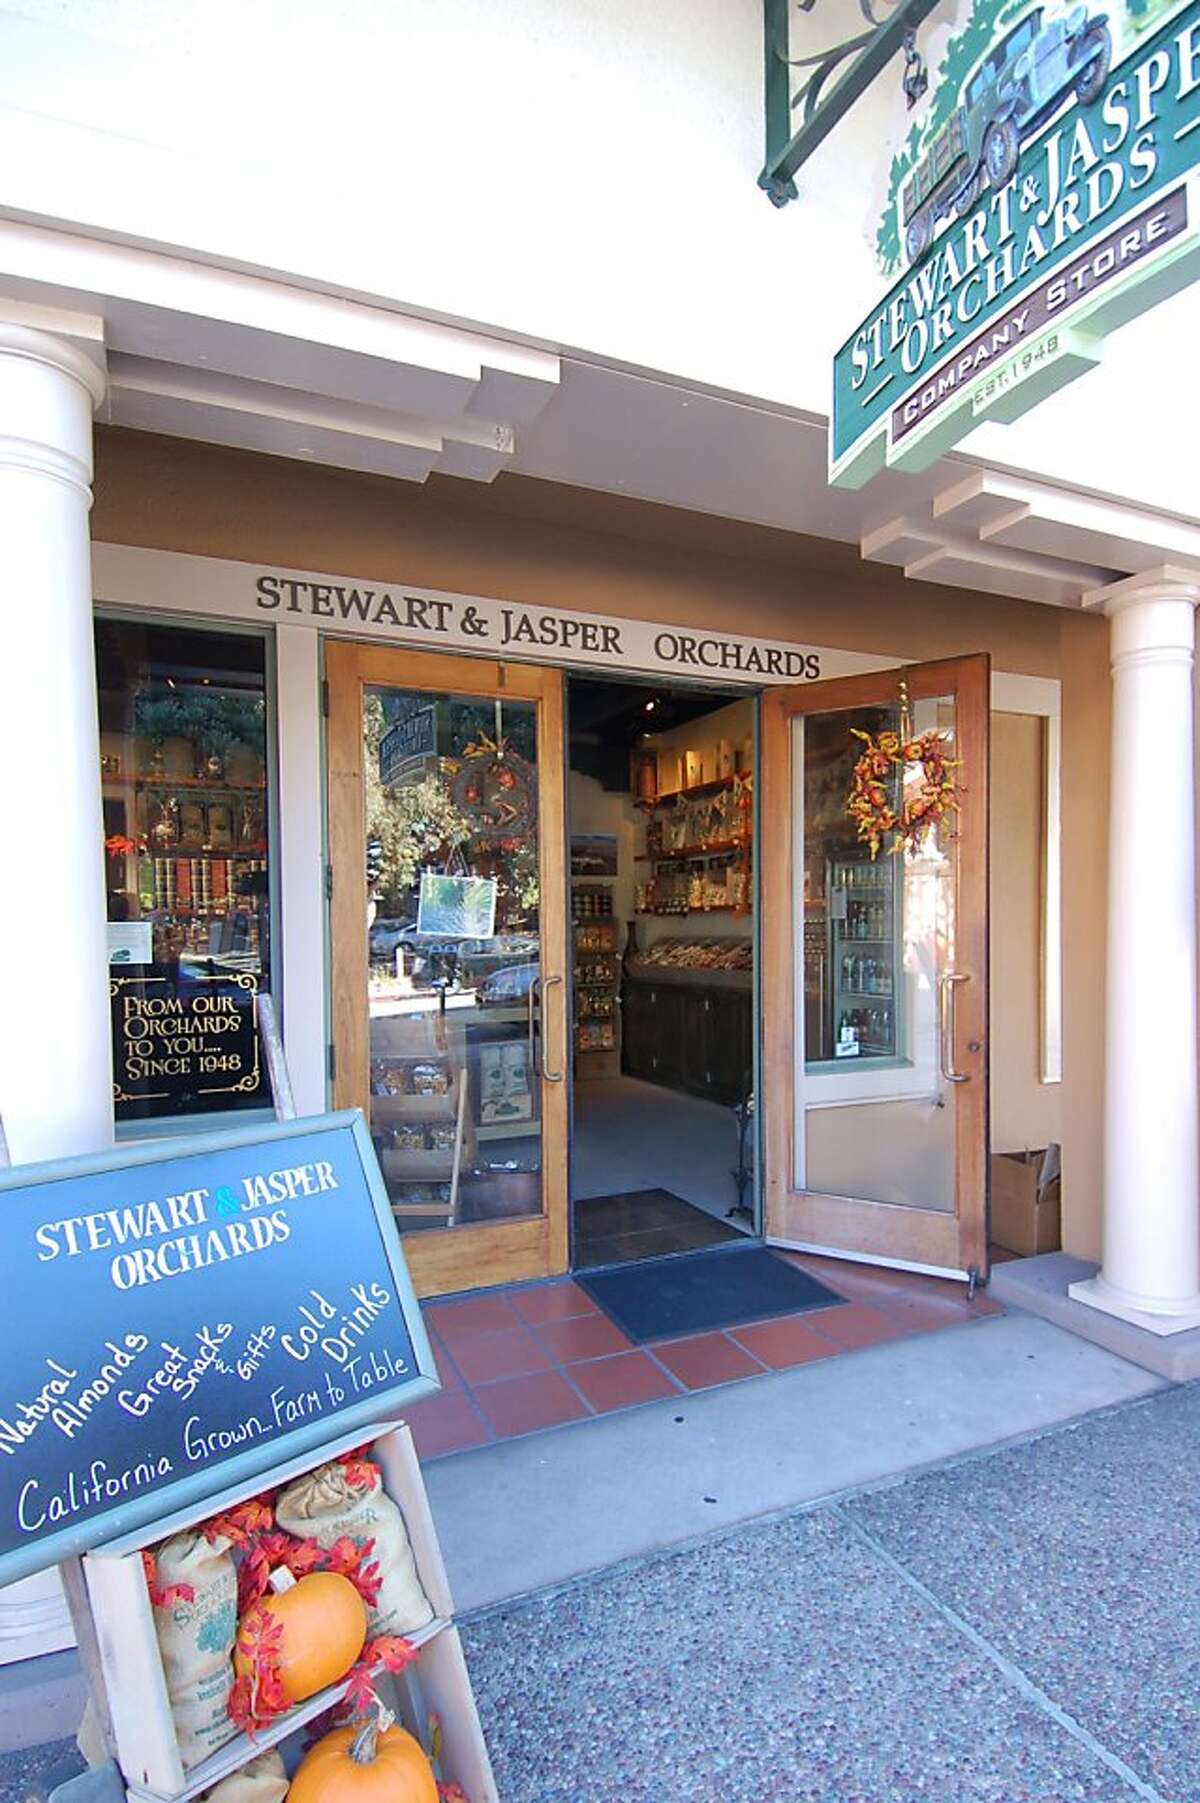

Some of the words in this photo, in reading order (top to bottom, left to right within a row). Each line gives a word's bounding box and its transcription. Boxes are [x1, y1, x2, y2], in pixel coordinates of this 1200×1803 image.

[851, 182, 1027, 391] STEWART
[1018, 177, 1041, 210] &
[901, 131, 1158, 375] ORCHARDS
[902, 309, 1032, 426] COMPANY
[1046, 211, 1172, 313] STORE
[1012, 335, 1059, 377] 1948
[255, 575, 453, 633] STEWART
[460, 605, 489, 637] &
[500, 608, 624, 654] JASPER
[653, 632, 822, 680] ORCHARDS
[124, 996, 184, 1018] FROM
[193, 996, 239, 1014] OUR
[124, 1015, 242, 1040] ORCHARDS
[124, 1039, 154, 1057] TO
[125, 1056, 191, 1080] SINCE
[199, 1053, 242, 1073] 1948
[35, 1188, 210, 1262] STEWART
[215, 1186, 241, 1218] &
[241, 1161, 339, 1211] JASPER
[111, 1210, 291, 1290] ORCHARDS
[237, 1324, 277, 1381] Gifts
[281, 1290, 338, 1362] Cold
[0, 1358, 77, 1455] Natural
[51, 1332, 149, 1438] Almonds
[118, 1342, 188, 1418] Great
[17, 1453, 174, 1532] California
[325, 1373, 345, 1407] to
[343, 1350, 409, 1393] Table
